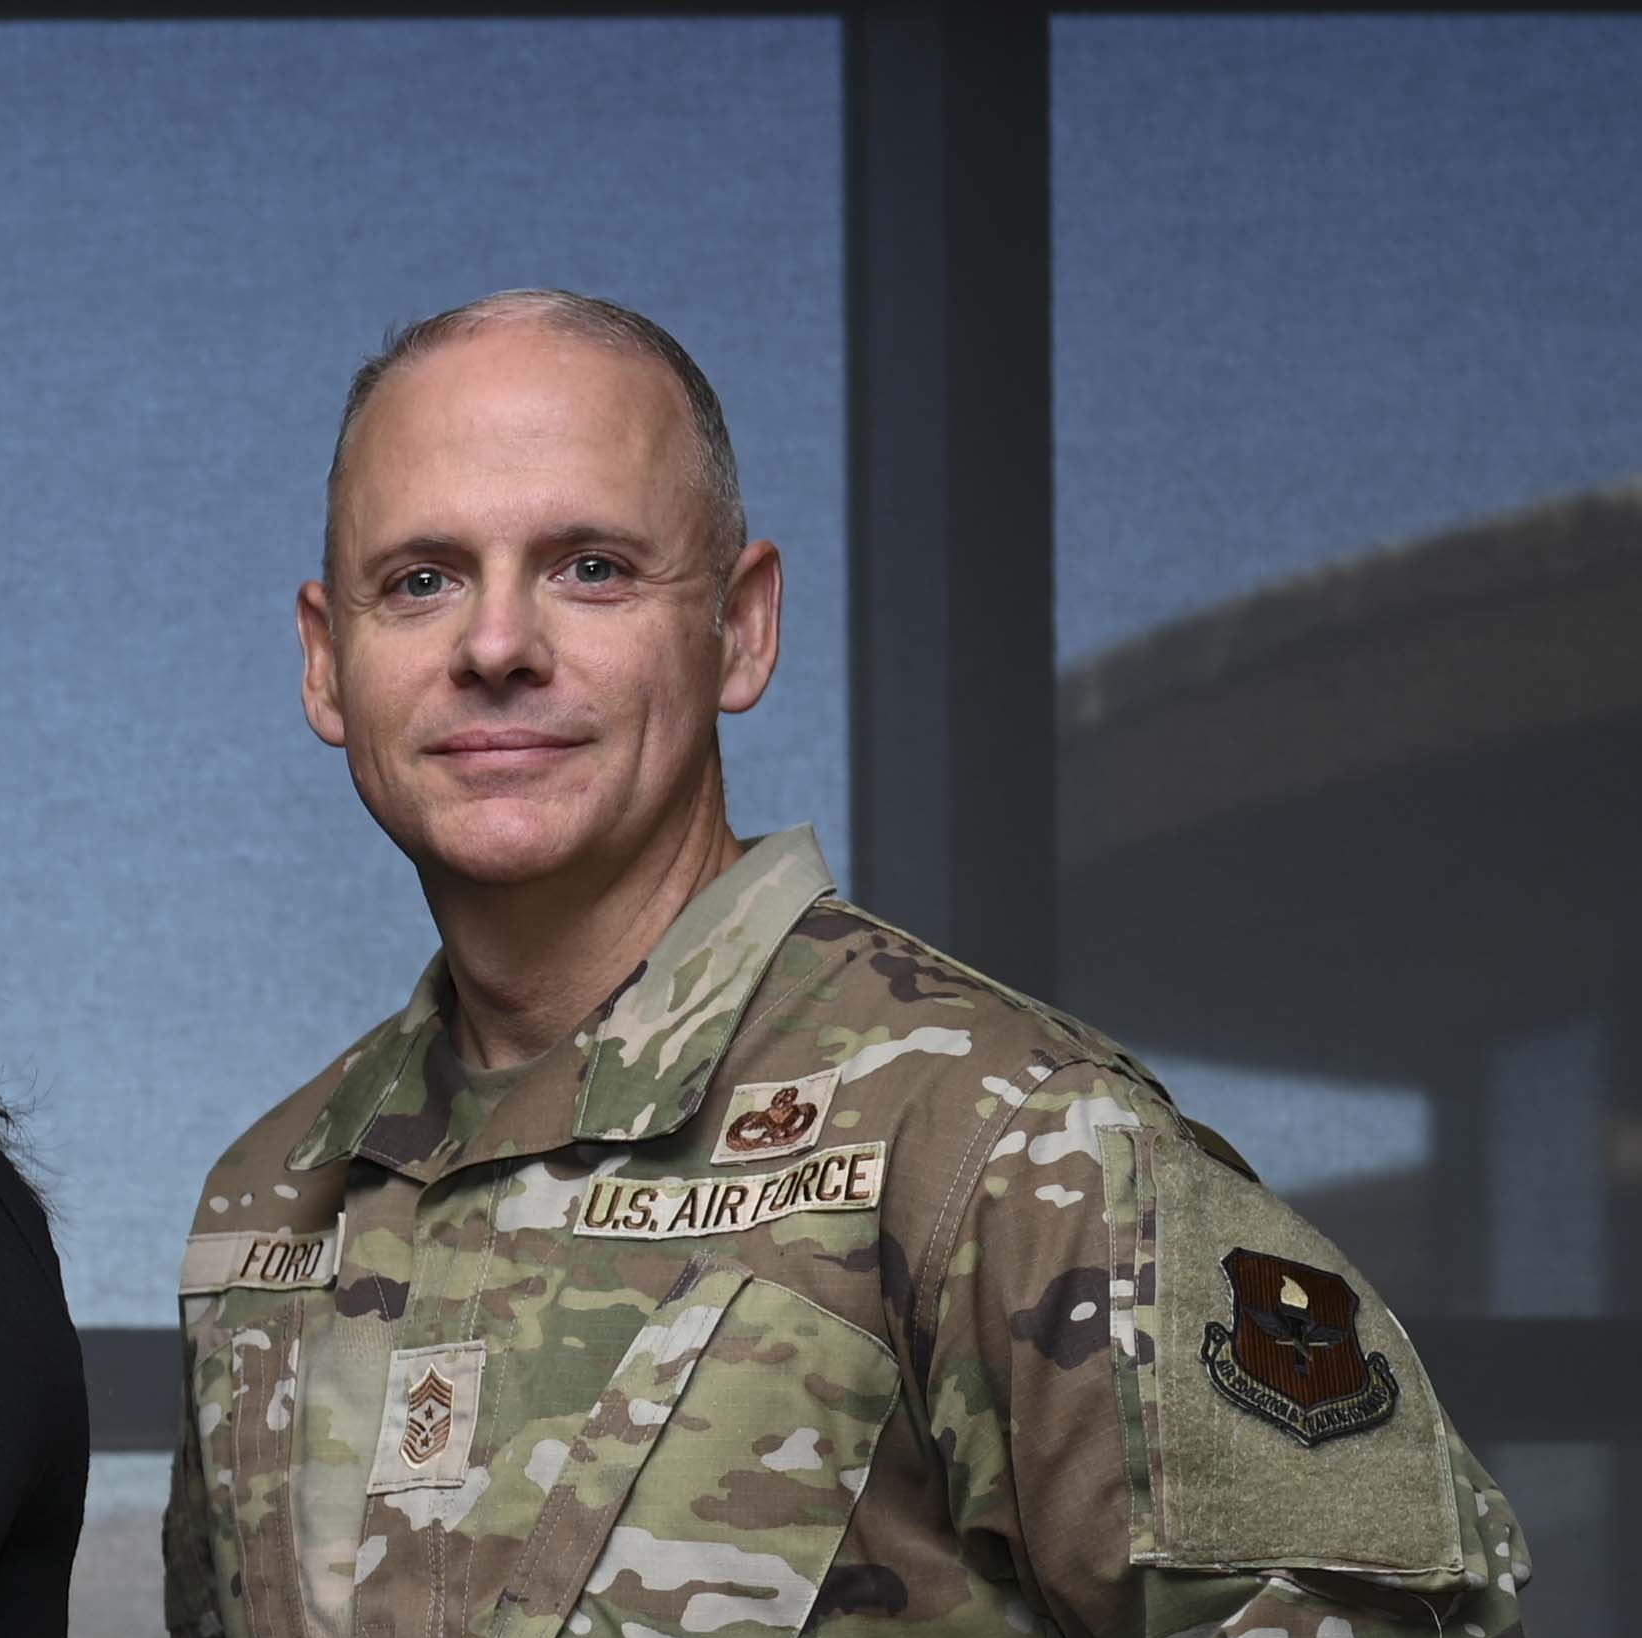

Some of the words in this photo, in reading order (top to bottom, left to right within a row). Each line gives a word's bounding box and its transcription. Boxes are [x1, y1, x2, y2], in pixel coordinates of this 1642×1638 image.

[583, 1182, 659, 1234] U.S.
[668, 1184, 750, 1233] AIR
[751, 1152, 876, 1223] FORCE
[239, 1237, 324, 1283] FORD
